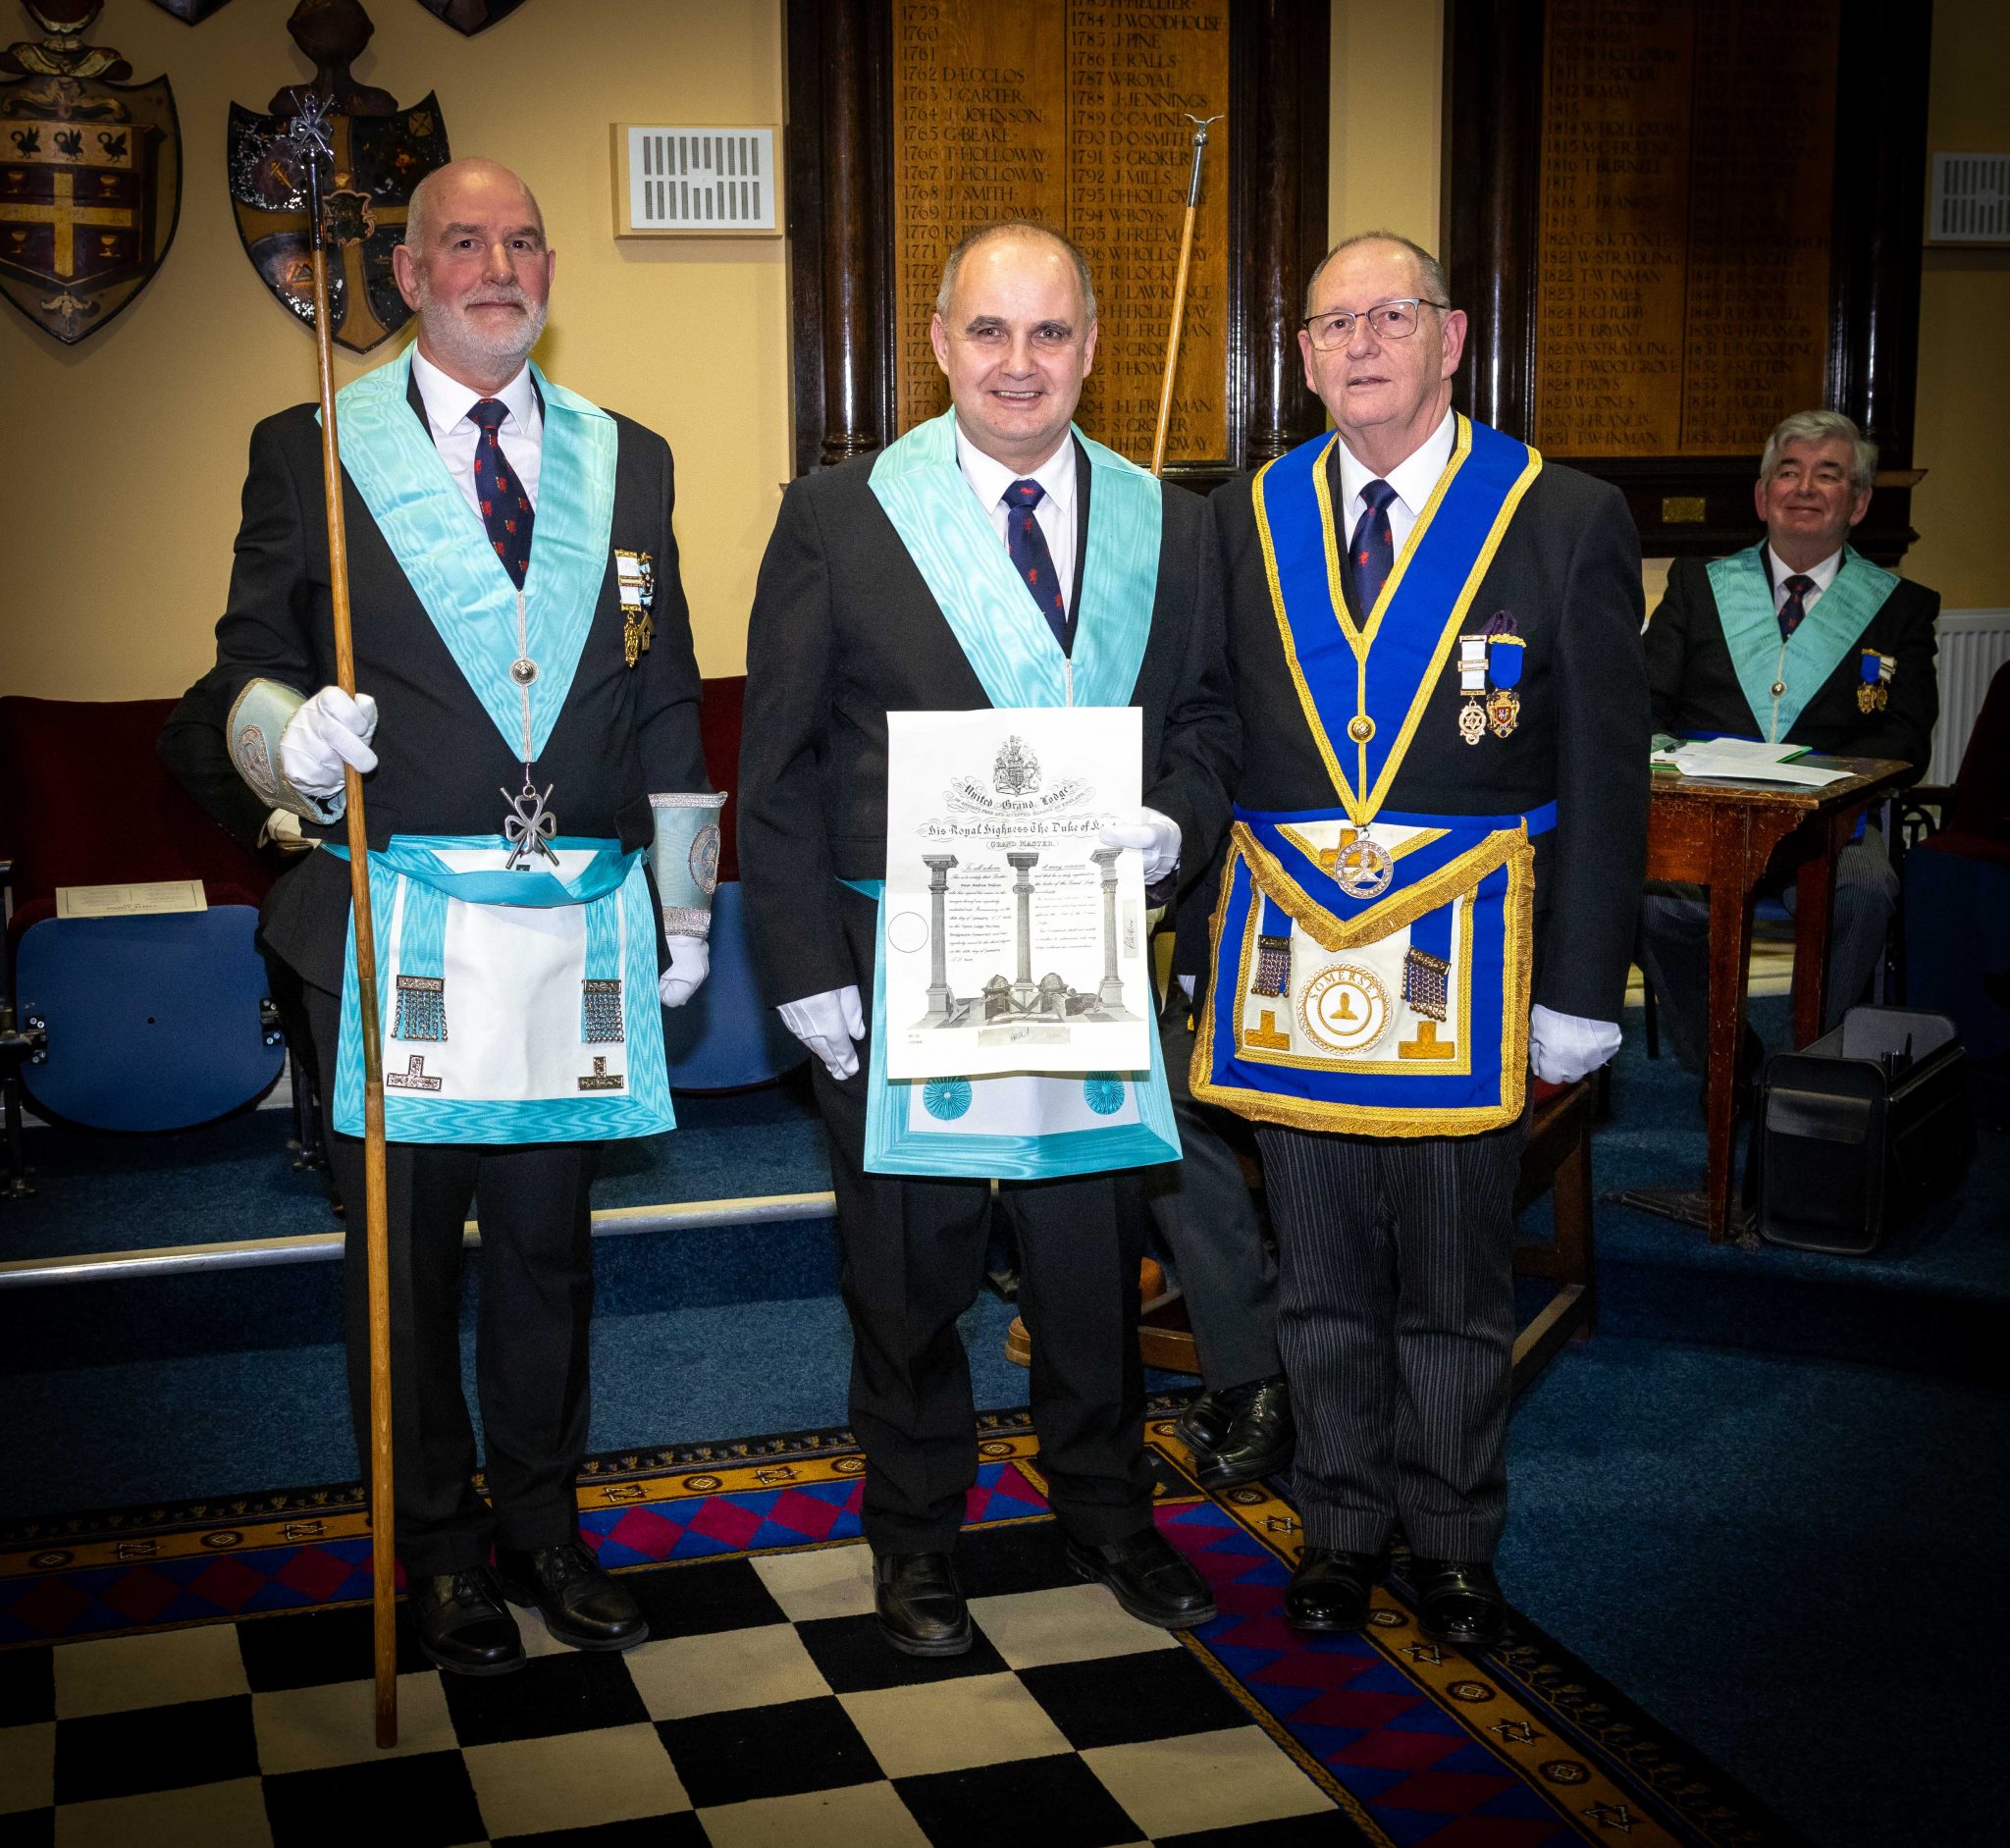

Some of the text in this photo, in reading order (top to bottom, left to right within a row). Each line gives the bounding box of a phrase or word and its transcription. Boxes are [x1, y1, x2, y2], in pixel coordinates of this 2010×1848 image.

[903, 6, 939, 21] 1759
[1073, 12, 1104, 27] 1784
[903, 26, 938, 41] 1760
[1073, 31, 1105, 47] 1785
[903, 46, 935, 61] 1761
[1073, 51, 1105, 67] 1786
[903, 66, 936, 81] 1762
[1073, 71, 1104, 86] 1787
[903, 86, 937, 101] 1763
[1073, 90, 1104, 106] 1788
[903, 106, 937, 121] 1764
[1073, 110, 1105, 126] 1789
[903, 126, 938, 140] 1765
[1073, 130, 1105, 145] 1790
[904, 146, 938, 160] 1766
[1073, 149, 1103, 165] 1791
[904, 166, 938, 181] 1767
[1073, 169, 1105, 184] 1792
[904, 185, 938, 200] 1768
[905, 205, 939, 220] 1769
[1073, 208, 1103, 223] 1794
[905, 225, 939, 239] 1770
[1073, 228, 1106, 242] 1795
[905, 244, 936, 259] 1771
[905, 264, 939, 279] 1772
[907, 322, 931, 338] 177
[907, 342, 934, 357] 177
[907, 361, 938, 377] 1777
[965, 784, 1070, 811] United Grand Lodge
[927, 824, 947, 836] His
[949, 822, 981, 838] Royal
[983, 822, 1029, 838] Highness
[1031, 821, 1049, 835] The
[1052, 820, 1078, 833] Duke
[1081, 819, 1090, 833] of
[1309, 970, 1381, 1001] SOMERSET
